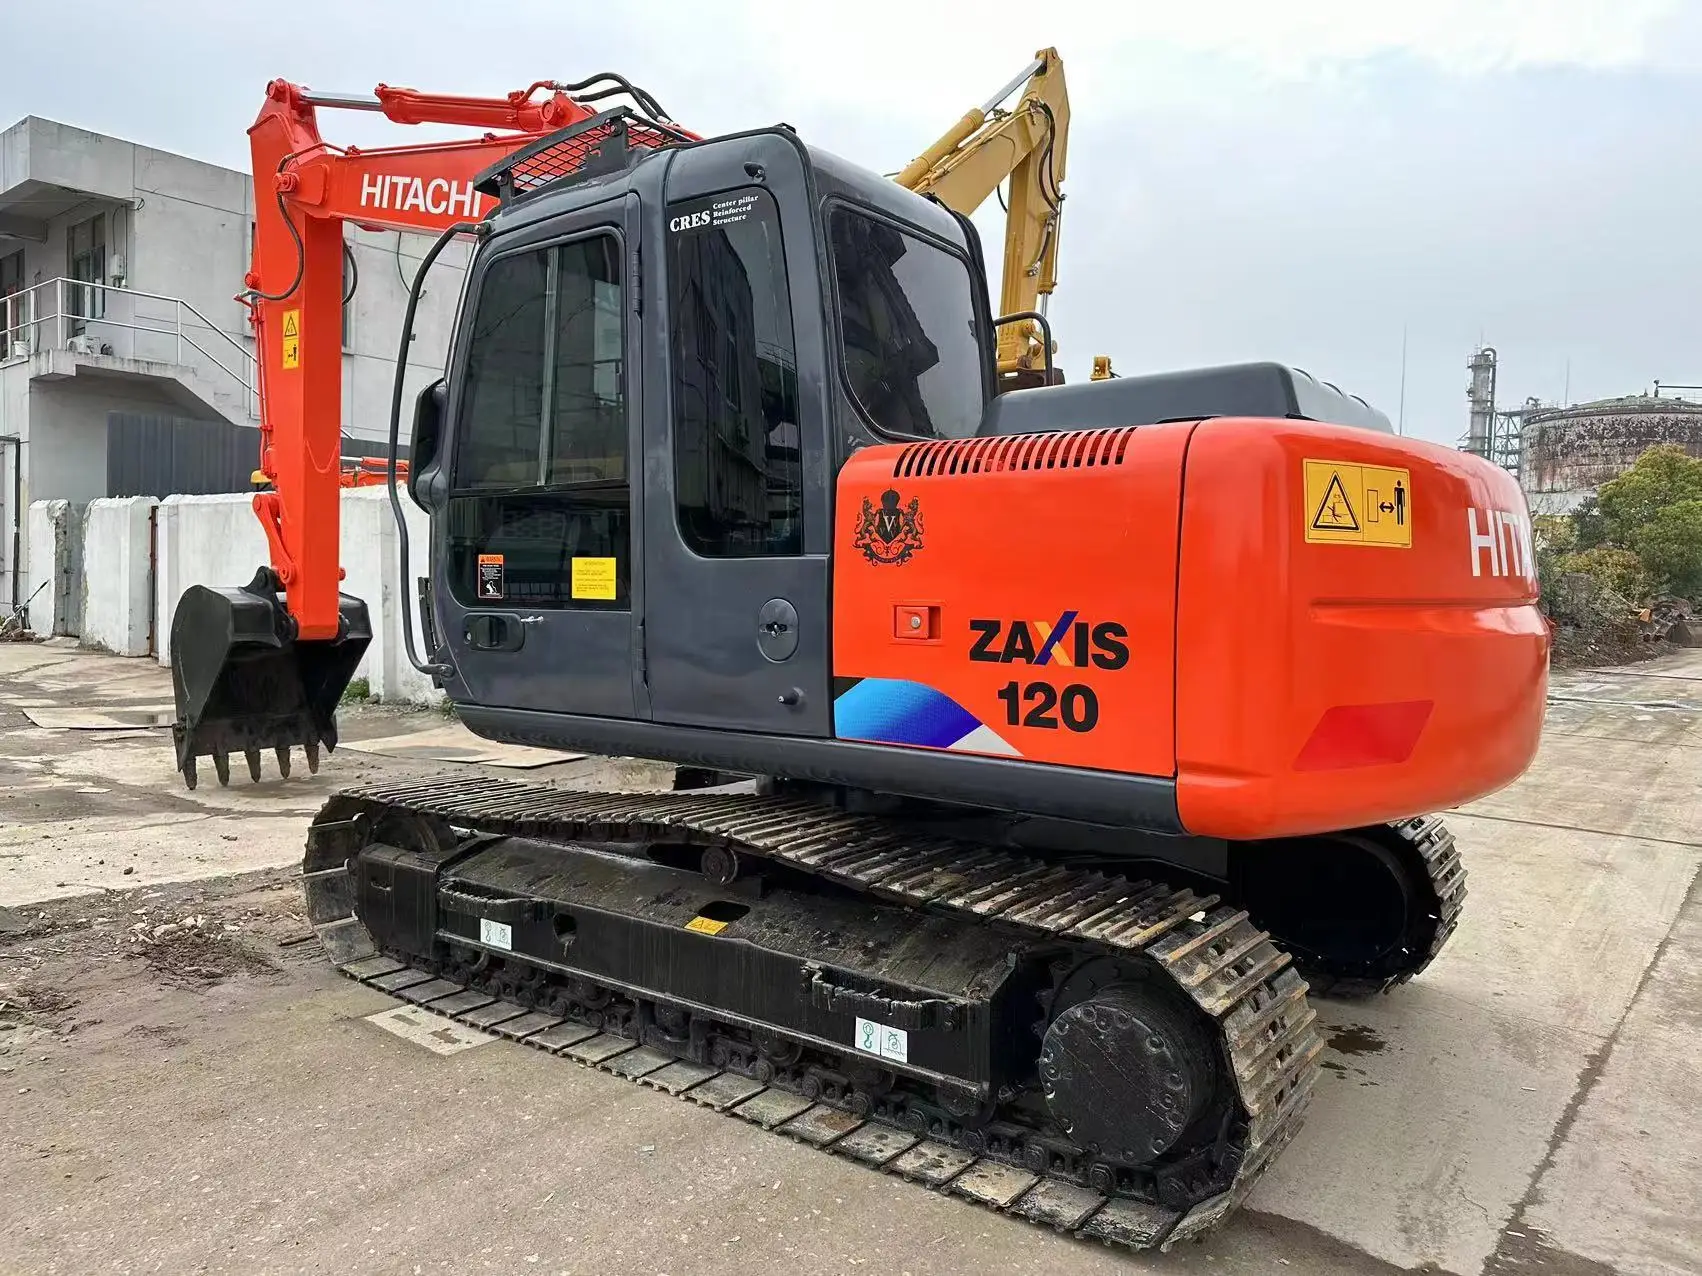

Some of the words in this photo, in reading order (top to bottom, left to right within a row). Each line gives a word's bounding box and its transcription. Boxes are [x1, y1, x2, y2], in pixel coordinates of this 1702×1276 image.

[360, 173, 482, 218] HITACHI
[712, 200, 737, 210] Center
[738, 195, 759, 205] pillar
[669, 210, 711, 232] CRES
[712, 204, 752, 218] Reinforced
[712, 214, 747, 226] Structure
[969, 610, 1130, 671] ZAXIS
[997, 681, 1099, 733] 120
